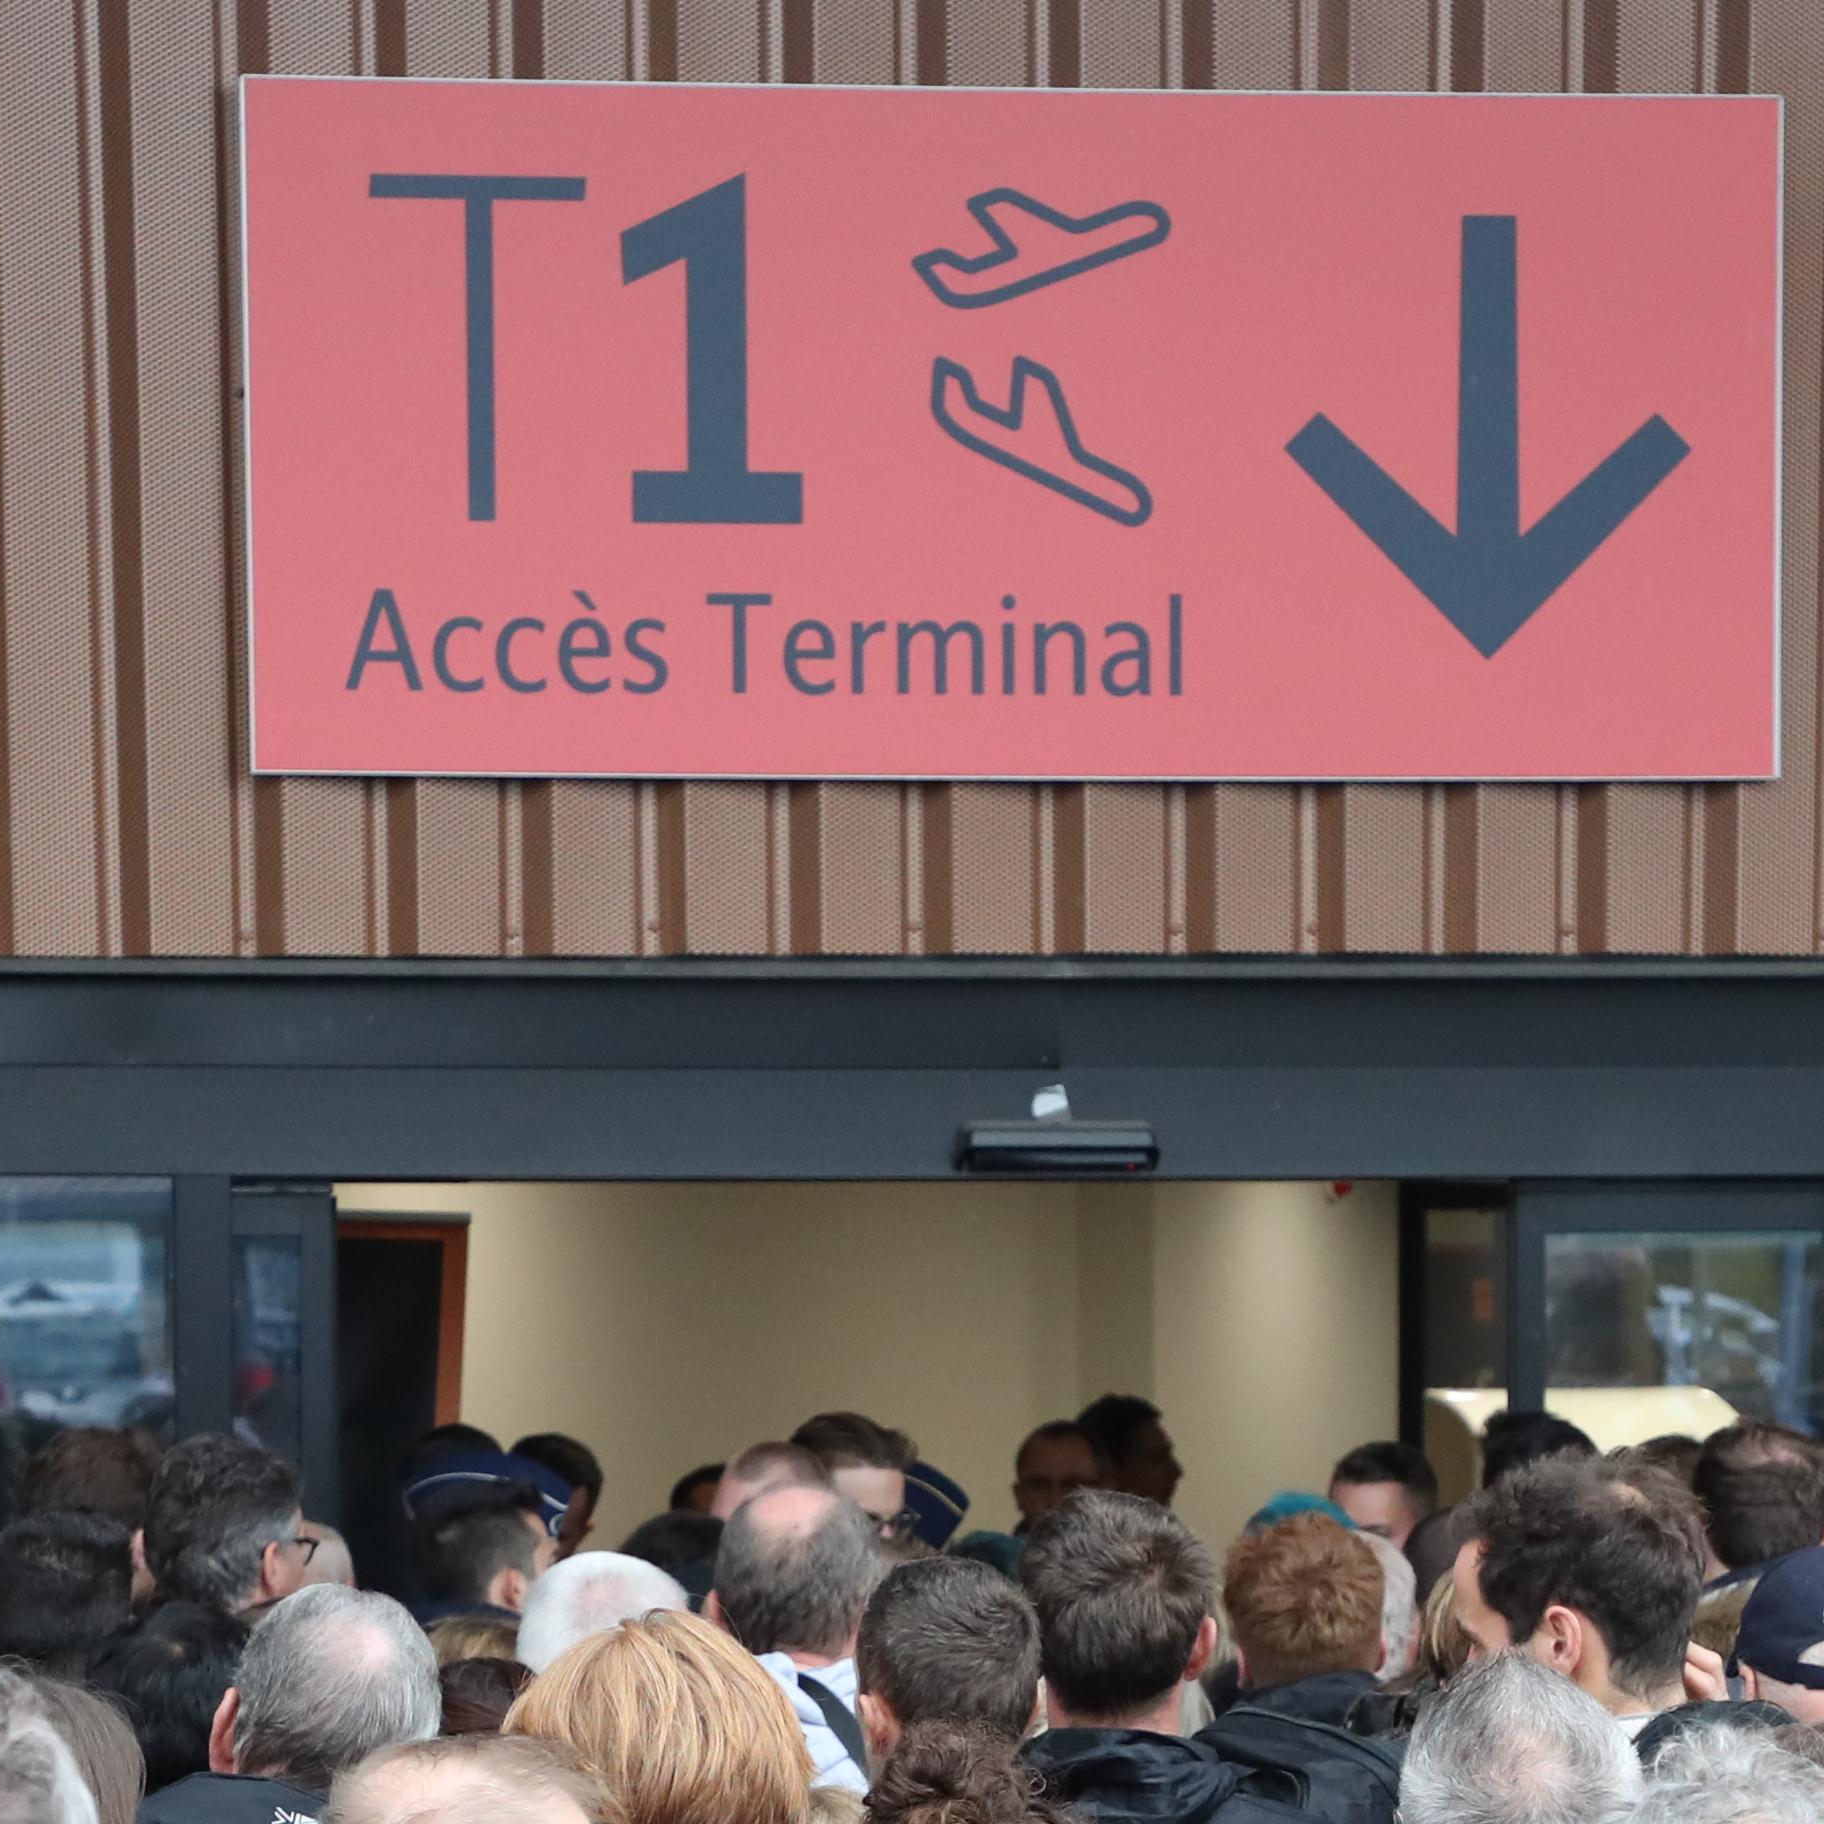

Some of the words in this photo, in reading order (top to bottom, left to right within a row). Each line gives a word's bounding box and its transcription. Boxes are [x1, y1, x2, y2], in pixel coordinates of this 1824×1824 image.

[367, 173, 805, 526] T1
[345, 588, 669, 695] Accès
[705, 593, 1183, 698] Terminal
